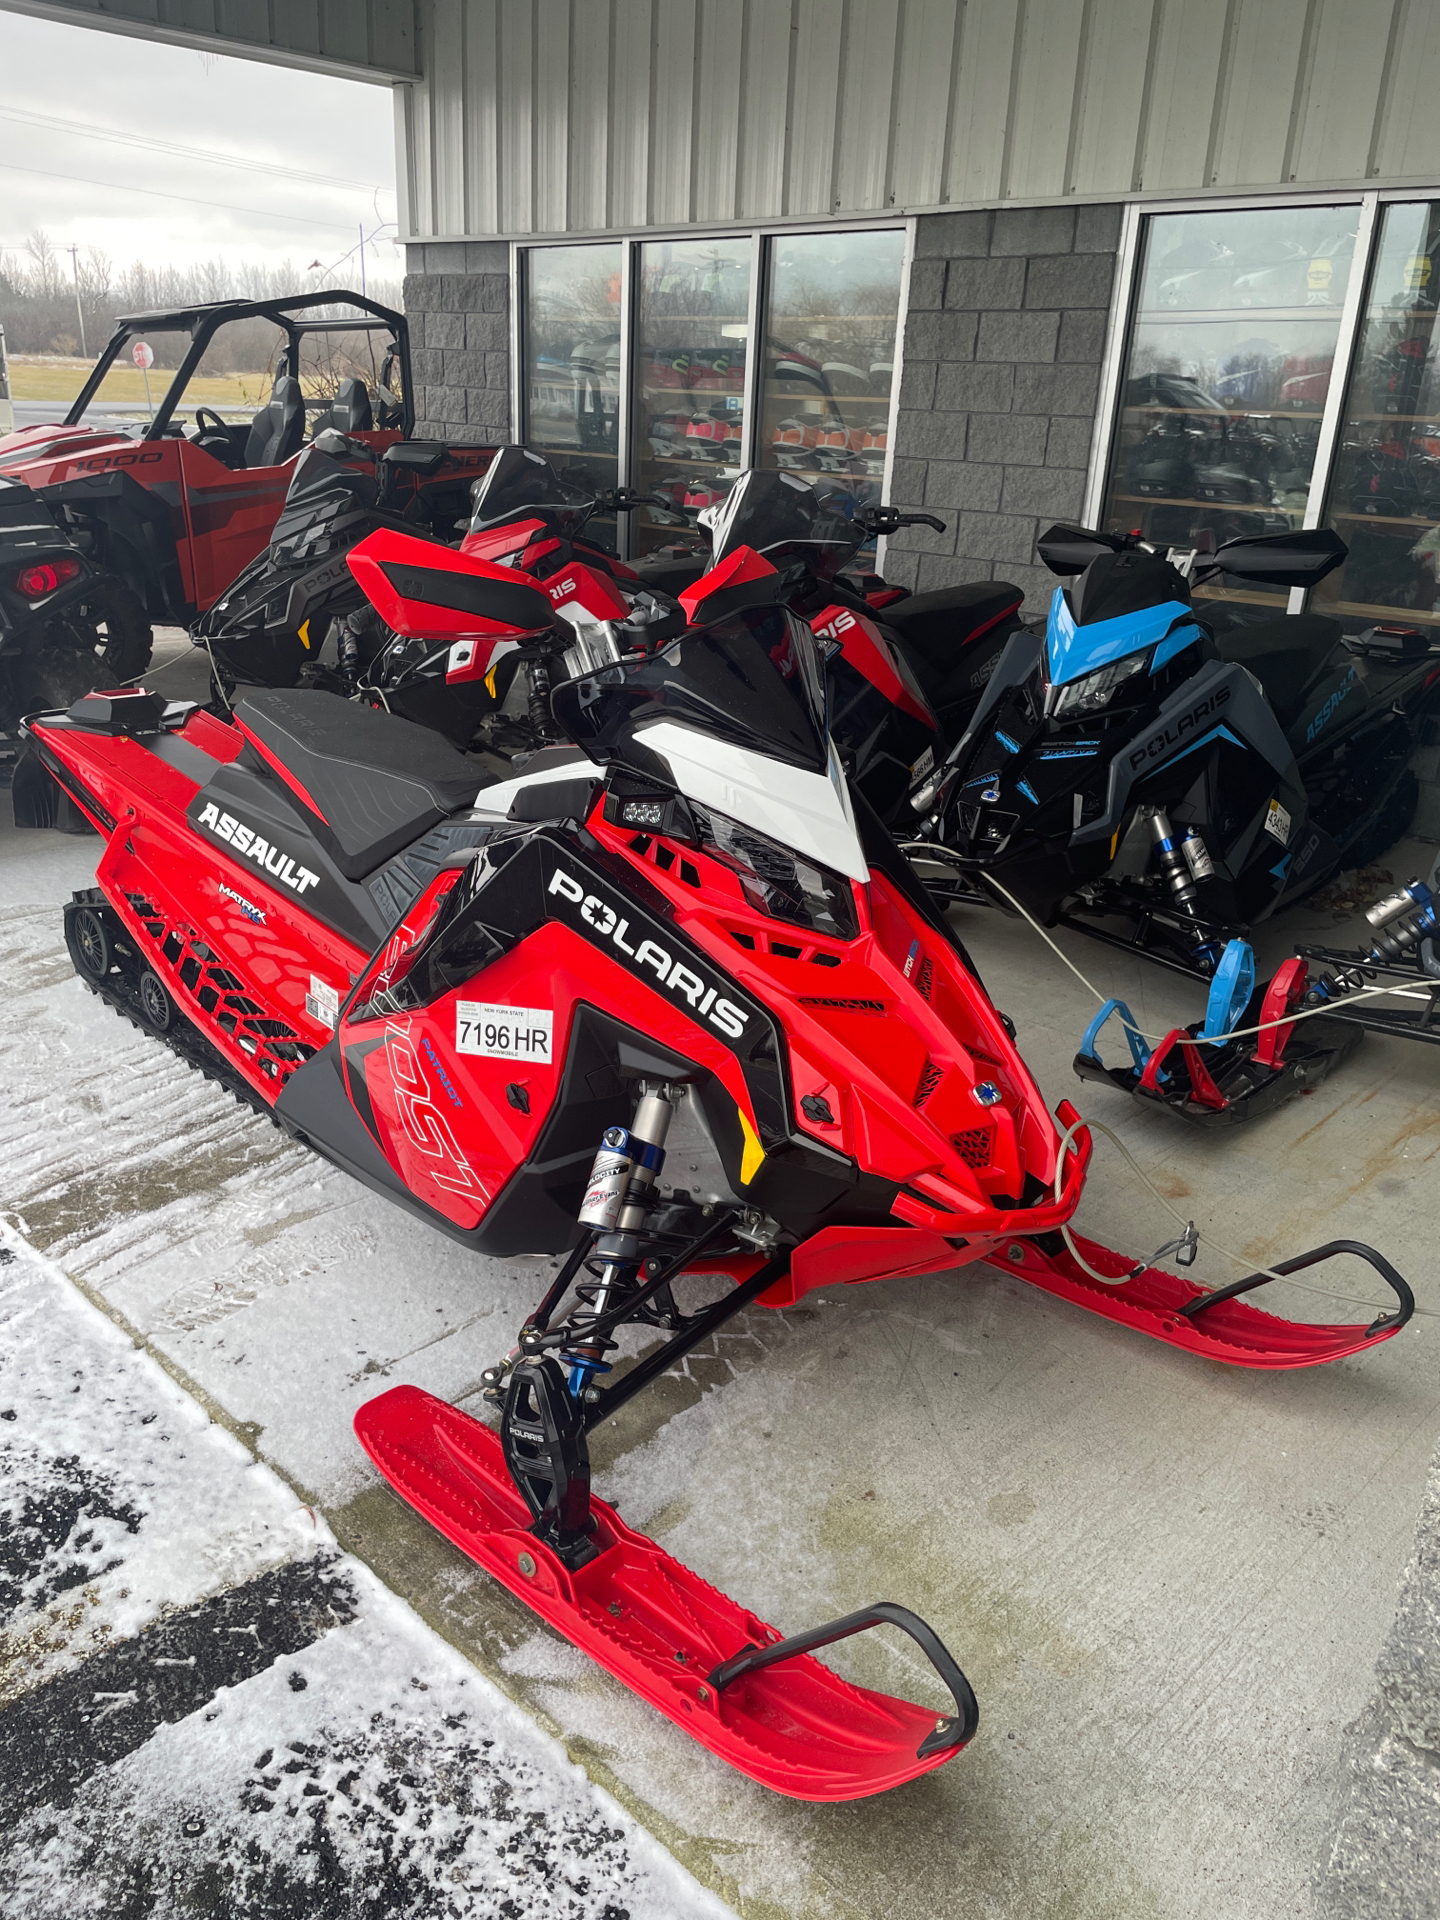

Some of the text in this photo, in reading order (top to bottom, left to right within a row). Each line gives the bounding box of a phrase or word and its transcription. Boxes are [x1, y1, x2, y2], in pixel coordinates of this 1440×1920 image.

[77, 453, 163, 472] 1000
[1129, 685, 1231, 771] POLARIS
[197, 801, 321, 894] ASSAULT
[218, 882, 268, 926] MATRYX
[548, 868, 750, 1038] POLARIS
[459, 1021, 548, 1054] 7196 HR
[487, 1048, 519, 1057] SNOWMOBILE
[421, 1038, 463, 1109] PATRIOT
[509, 1426, 545, 1443] POLARIS
